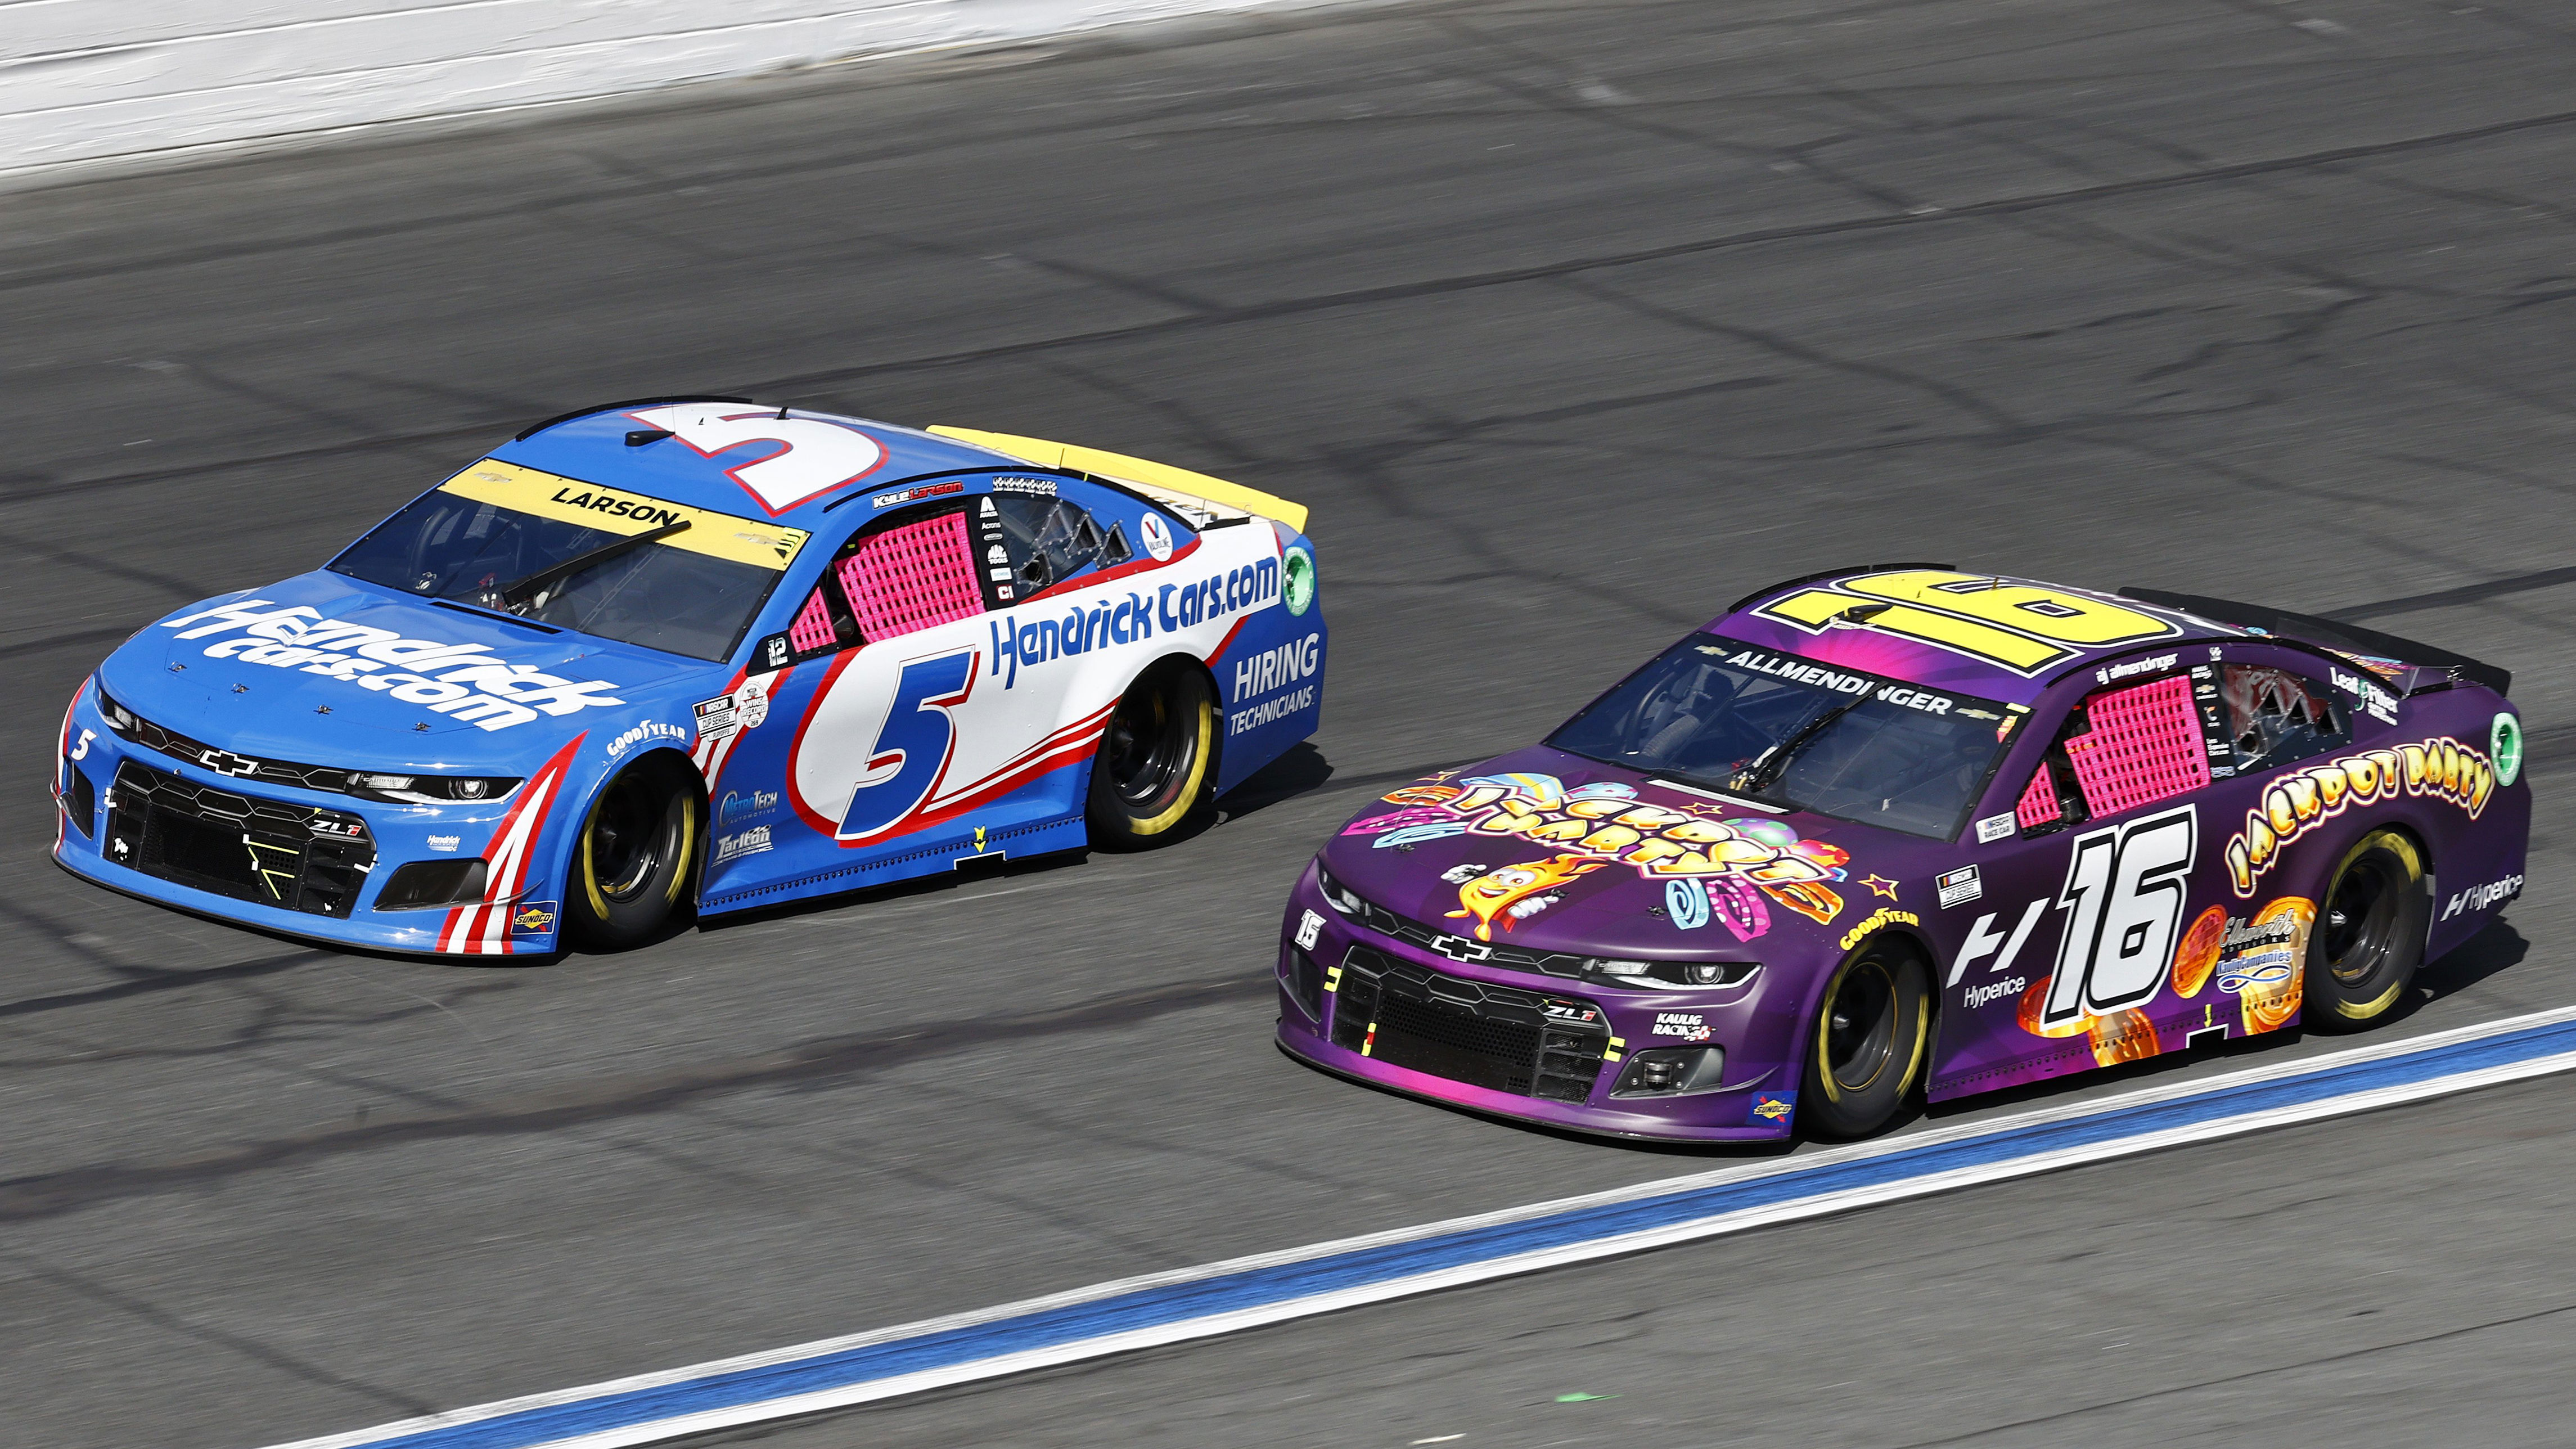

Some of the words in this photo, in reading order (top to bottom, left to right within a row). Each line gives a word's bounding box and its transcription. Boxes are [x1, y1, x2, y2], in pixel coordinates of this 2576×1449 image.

[620, 402, 890, 518] 5
[551, 487, 680, 526] LARSON
[160, 599, 627, 718] Hendrick
[768, 637, 789, 667] 12
[1233, 632, 1319, 704] HIRING
[1724, 651, 1953, 716] ALLMENDINGER
[706, 698, 728, 713] NASCAR
[743, 705, 765, 716] RECORD
[746, 697, 763, 708] WINS
[1230, 685, 1314, 736] TECHNICIANS
[606, 719, 686, 756] GOODYEAR
[702, 719, 711, 728] CUP
[713, 713, 729, 724] SERIES
[71, 728, 97, 760] 5
[834, 644, 979, 841] 5
[309, 820, 362, 836] ZL1
[2469, 874, 2524, 911] Hyperice
[517, 914, 551, 924] SUNOCO
[1840, 907, 1919, 951] GOODYEAR
[2039, 803, 2196, 1032] 16
[1963, 975, 2026, 1009] Hyperice
[1542, 1005, 1597, 1022] ZL1
[1656, 1012, 1703, 1025] KAULIG
